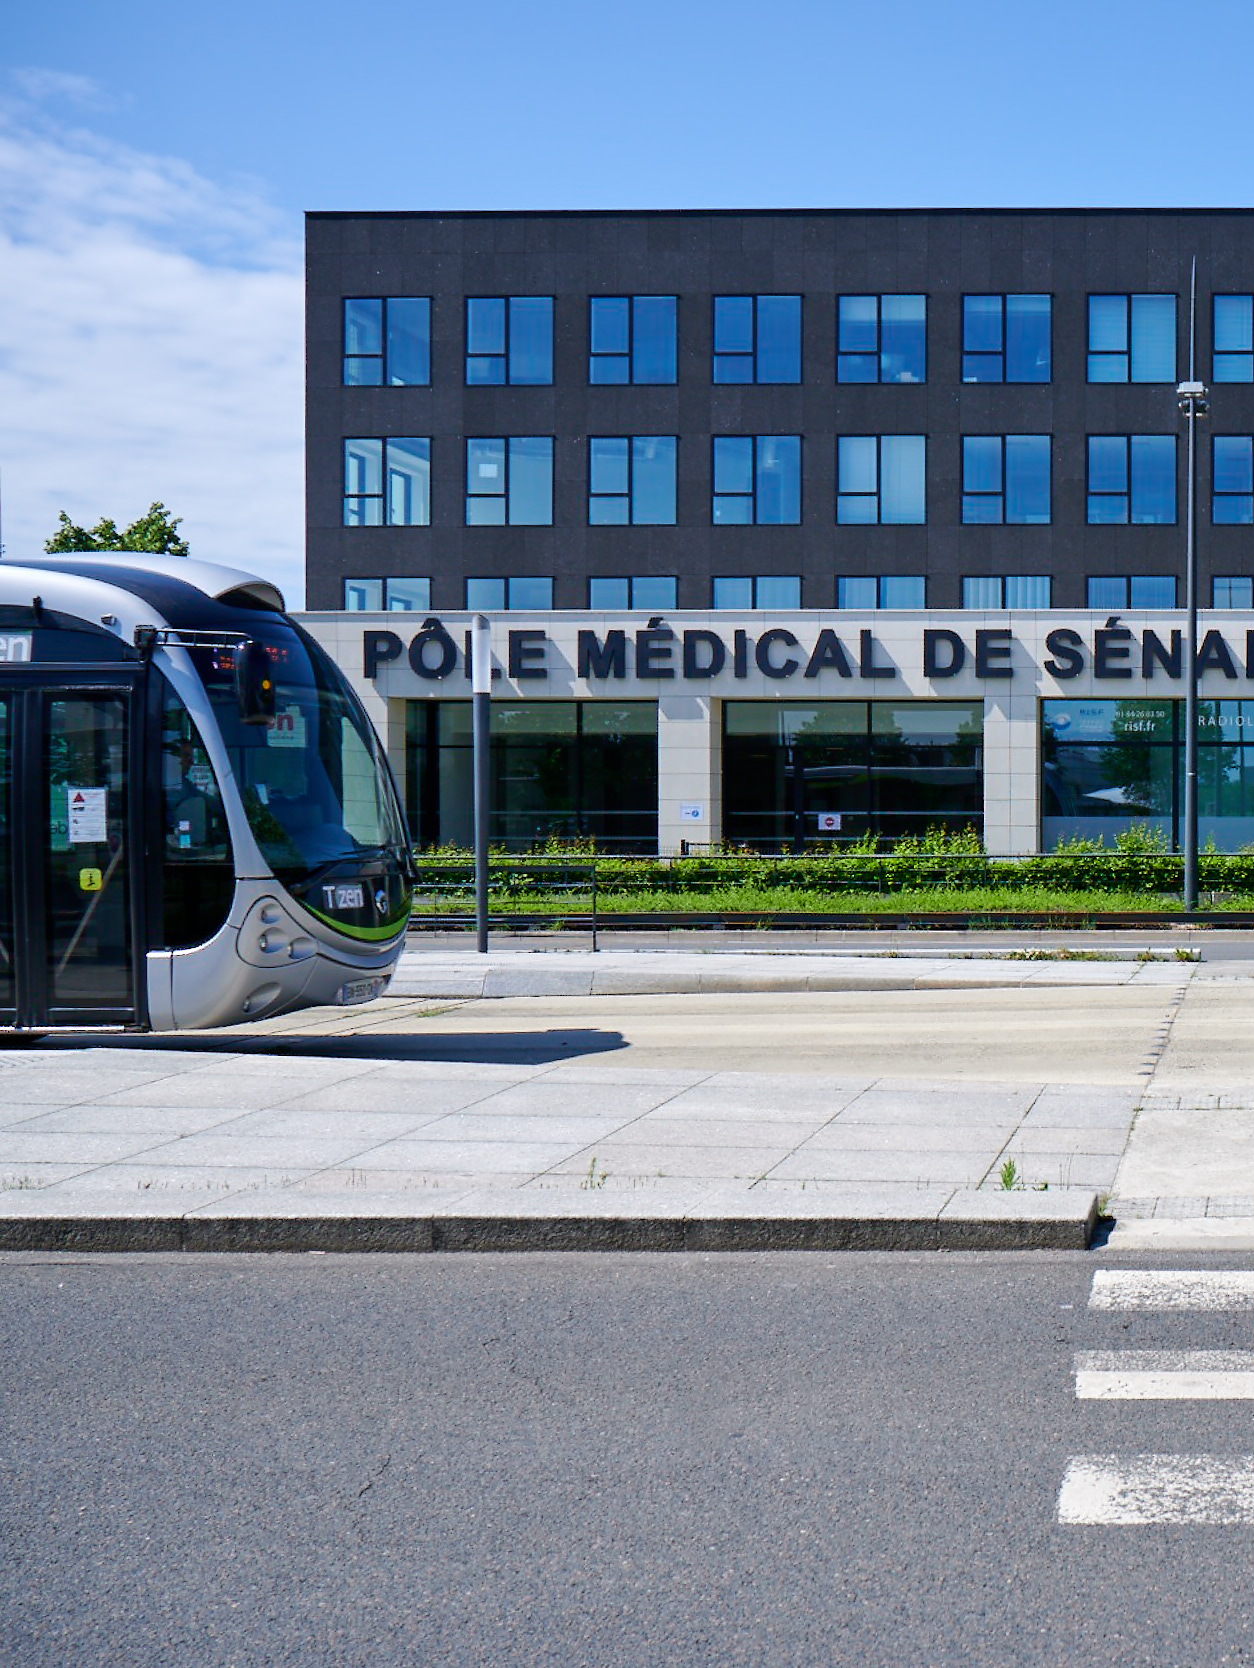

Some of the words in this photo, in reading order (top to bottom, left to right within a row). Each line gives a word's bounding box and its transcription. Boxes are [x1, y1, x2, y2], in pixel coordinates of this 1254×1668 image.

[363, 617, 548, 680] PÔLE
[577, 616, 897, 680] MÉDICAL
[924, 629, 1014, 680] DE
